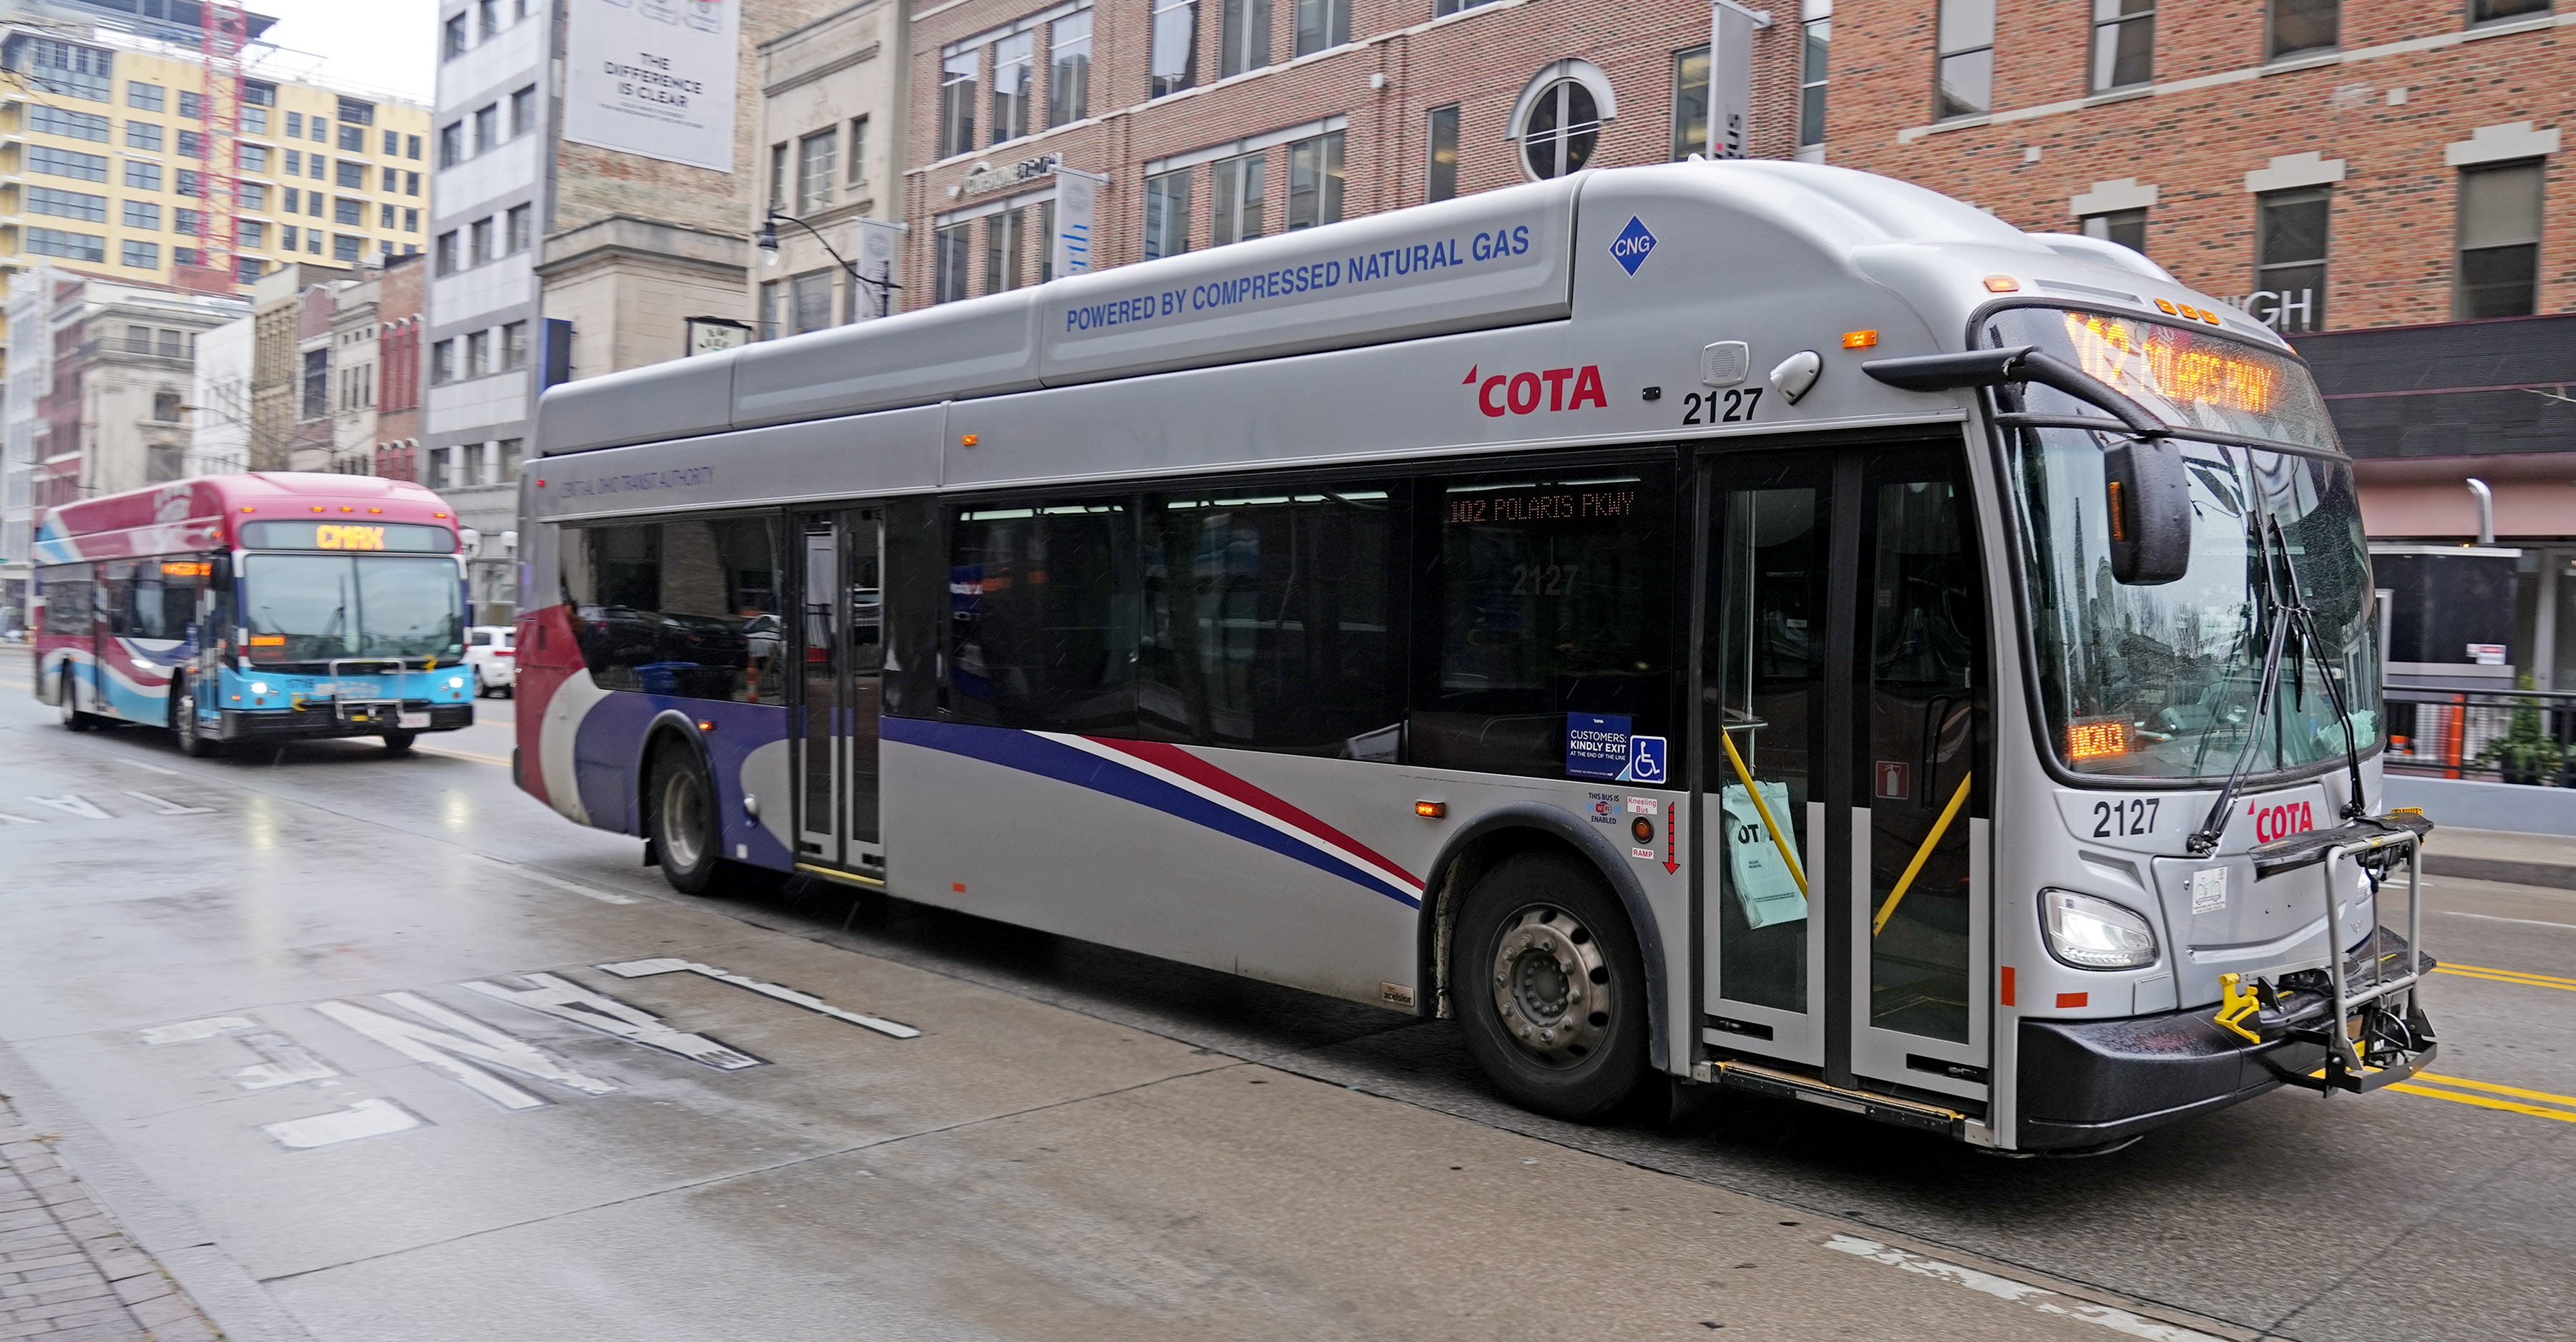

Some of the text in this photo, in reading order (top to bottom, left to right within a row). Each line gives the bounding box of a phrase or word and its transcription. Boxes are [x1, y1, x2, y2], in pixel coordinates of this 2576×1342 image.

[640, 52, 670, 70] THE
[604, 62, 703, 94] DIFFERENCE
[618, 82, 689, 107] IS CLEAR
[1614, 235, 1651, 258] CNG
[1065, 225, 1531, 333] POWERED BY COMPRESSED NATURAL GAS
[1477, 364, 1609, 418] COTA
[2140, 341, 2220, 405] POLARIS
[2225, 361, 2273, 414] PKWY
[1682, 386, 1765, 426] 2127
[1450, 491, 1634, 524] 102 POLARIS PKWY
[1511, 564, 1580, 596] 2127
[1570, 730, 1627, 744] CUSTOMERS:
[1570, 740, 1626, 754] KINDLY EXIT
[1628, 797, 1657, 808] Kneeling
[1591, 816, 1616, 825] ENABLED
[2093, 798, 2160, 838] 2127
[2255, 800, 2314, 844] COTA
[1633, 849, 1653, 858] RAMP
[1383, 991, 1412, 1004] xcelsior
